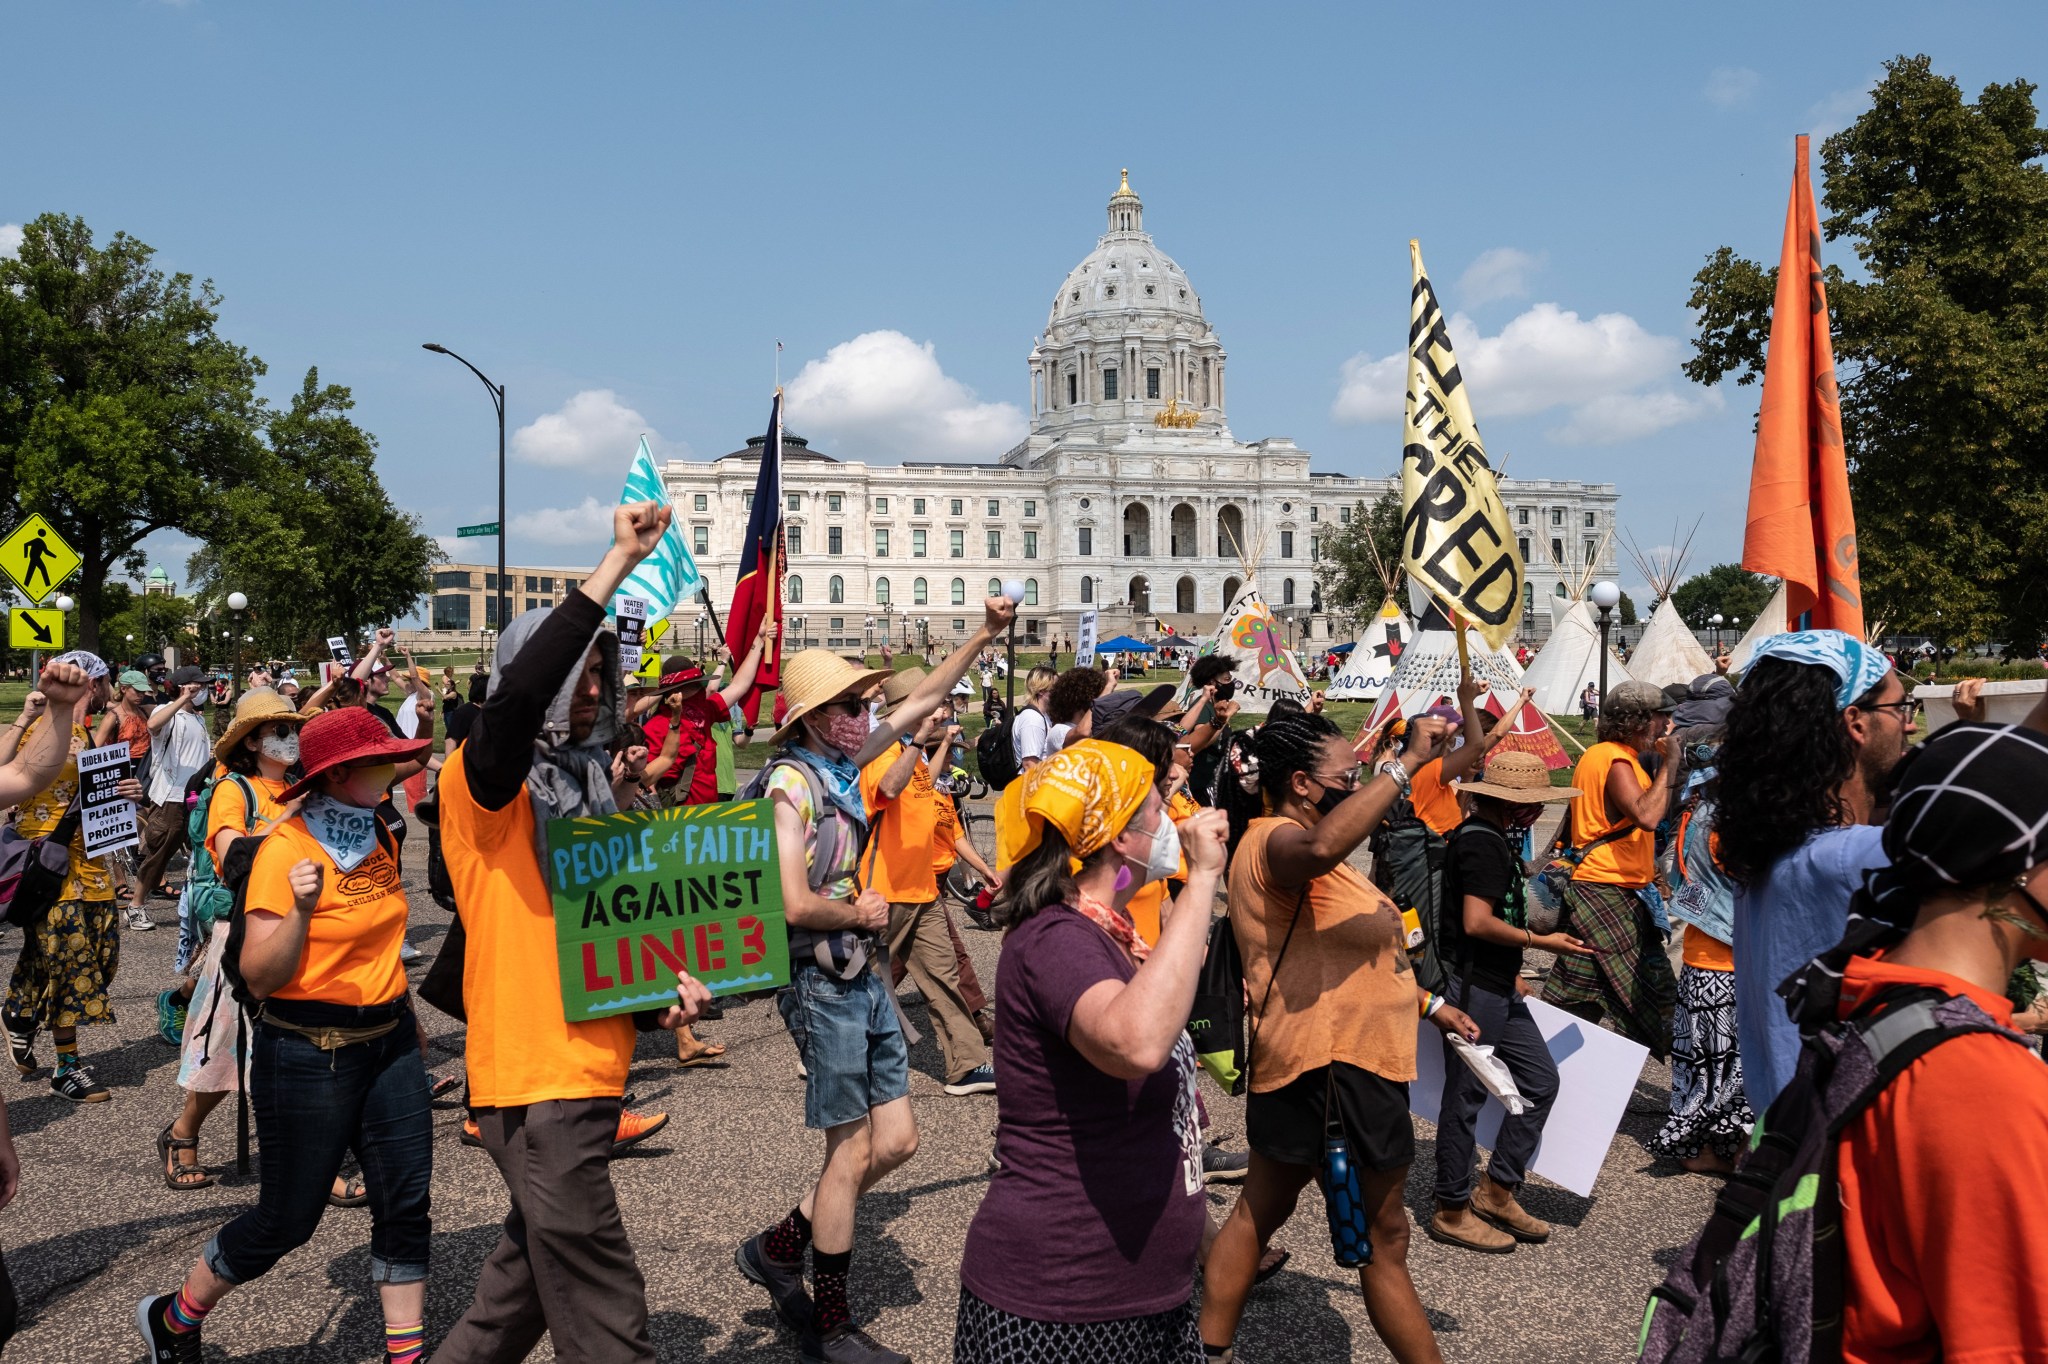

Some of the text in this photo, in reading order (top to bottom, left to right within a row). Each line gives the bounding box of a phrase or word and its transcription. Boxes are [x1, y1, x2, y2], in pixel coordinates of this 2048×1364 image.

[1412, 387, 1490, 487] THE
[623, 598, 644, 609] WATER
[624, 606, 643, 616] IS LIFE
[625, 656, 638, 664] VIDA
[82, 747, 127, 767] BIDEN & WALZ
[92, 768, 121, 784] BLUE
[96, 779, 120, 790] BUT NOT
[87, 785, 120, 803] GREE
[88, 802, 130, 821] PLANET
[99, 816, 120, 827] OVER
[322, 808, 374, 835] STOP
[87, 820, 133, 842] PROFITS
[326, 827, 367, 850] LINE
[337, 845, 349, 861] 3
[553, 824, 771, 890] PEOPLE of FAITH
[347, 890, 386, 907] CHILDREN
[581, 869, 763, 930] AGAINST
[581, 915, 767, 993] LINE 3
